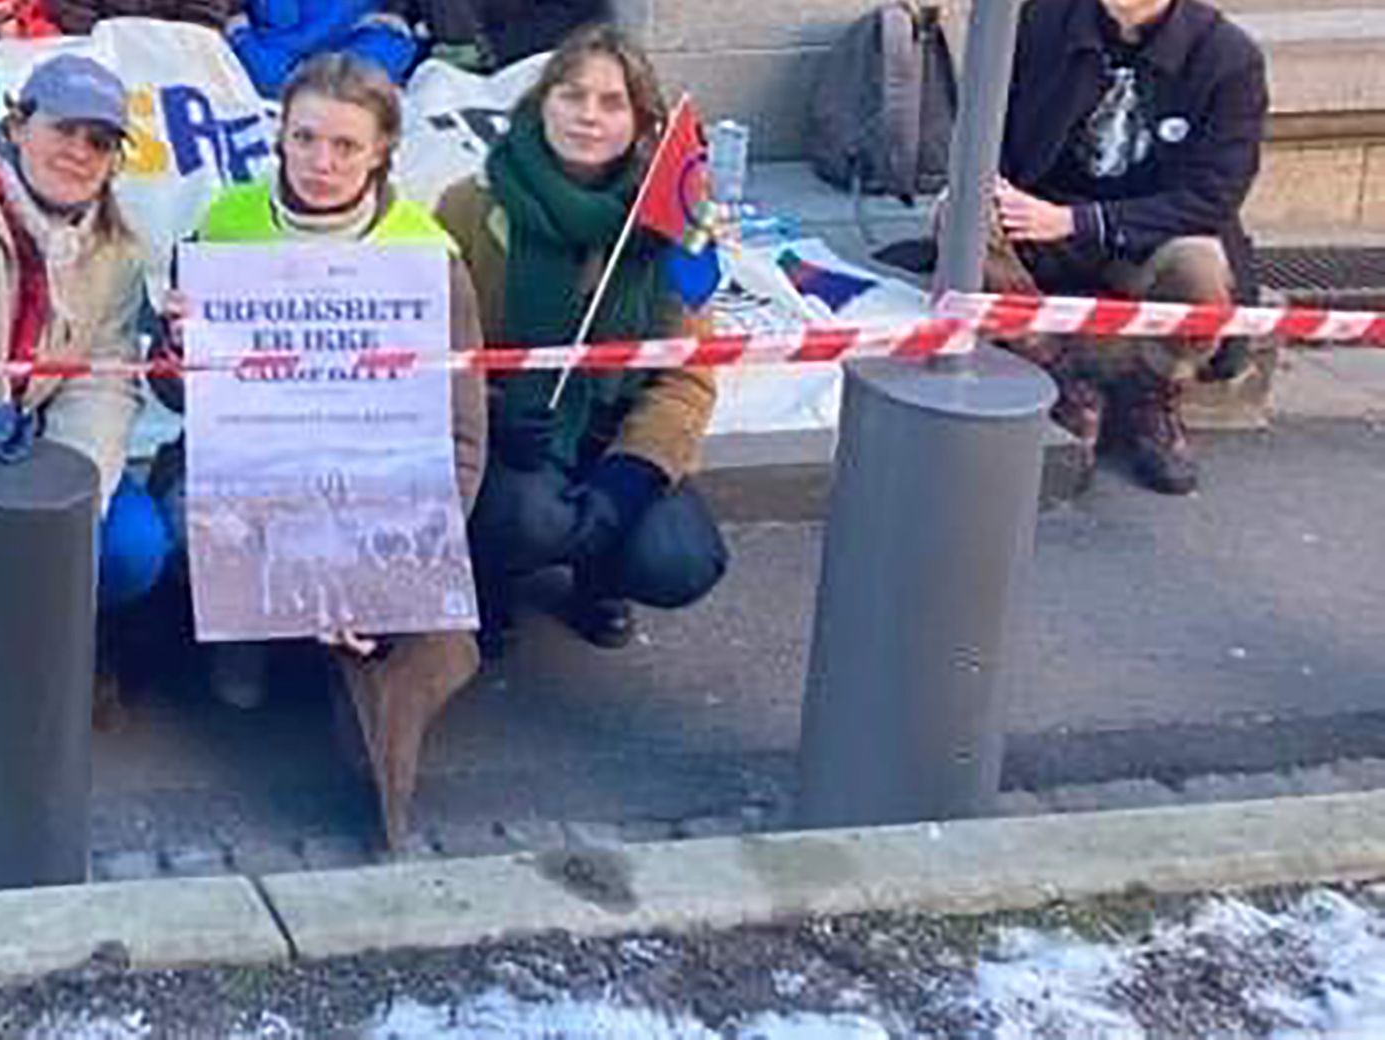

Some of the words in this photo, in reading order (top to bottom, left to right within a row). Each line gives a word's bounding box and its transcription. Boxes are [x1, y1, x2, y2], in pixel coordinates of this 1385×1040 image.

[203, 297, 432, 322] URFOLKSRETT
[252, 329, 293, 351] ER
[303, 329, 380, 351] IKKE
